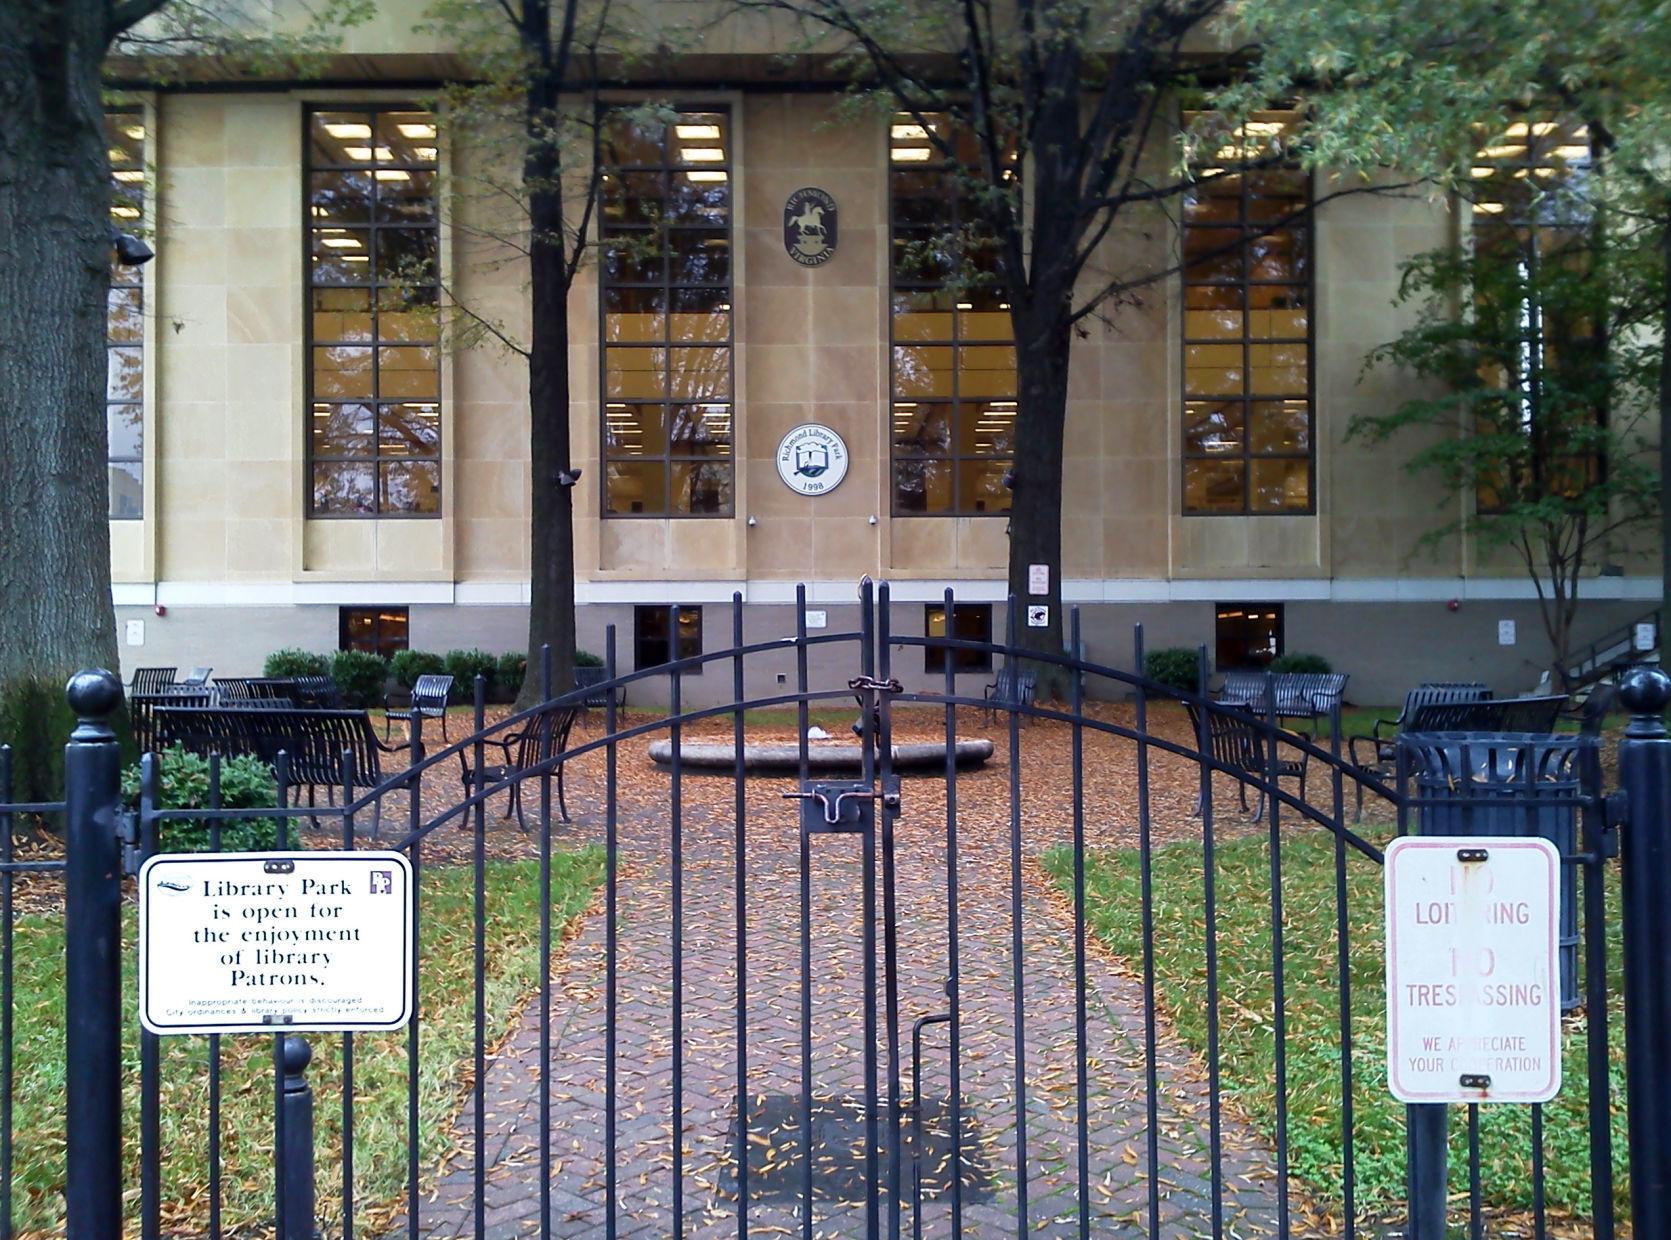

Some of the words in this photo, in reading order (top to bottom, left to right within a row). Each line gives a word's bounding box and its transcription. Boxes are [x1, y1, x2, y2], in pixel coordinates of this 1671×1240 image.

[790, 246, 835, 264] VIRGINIA
[782, 429, 808, 462] Richmond
[808, 428, 834, 445] Library
[831, 442, 843, 460] Park
[803, 482, 824, 491] 1998
[203, 879, 289, 900] Library
[301, 878, 353, 897] Park
[213, 903, 231, 920] is
[242, 905, 298, 923] open
[310, 902, 343, 919] for
[1415, 901, 1531, 926] LOIING
[193, 926, 231, 943] the
[241, 926, 361, 946] enjoyment
[220, 949, 244, 966] of
[256, 949, 332, 969] library
[231, 969, 326, 987] Patrons.
[188, 998, 248, 1008] Inappropriate
[309, 997, 363, 1006] discouraged
[1406, 983, 1543, 1007] TRESSSING
[166, 1008, 184, 1017] City
[187, 1008, 237, 1016] ordinances
[251, 1006, 278, 1015] library
[345, 1006, 385, 1015] enforced
[1423, 1036, 1442, 1052] WE
[1448, 1036, 1527, 1052] APECIATE
[1409, 1057, 1444, 1073] YOUR
[1450, 1056, 1542, 1072] CERATION
